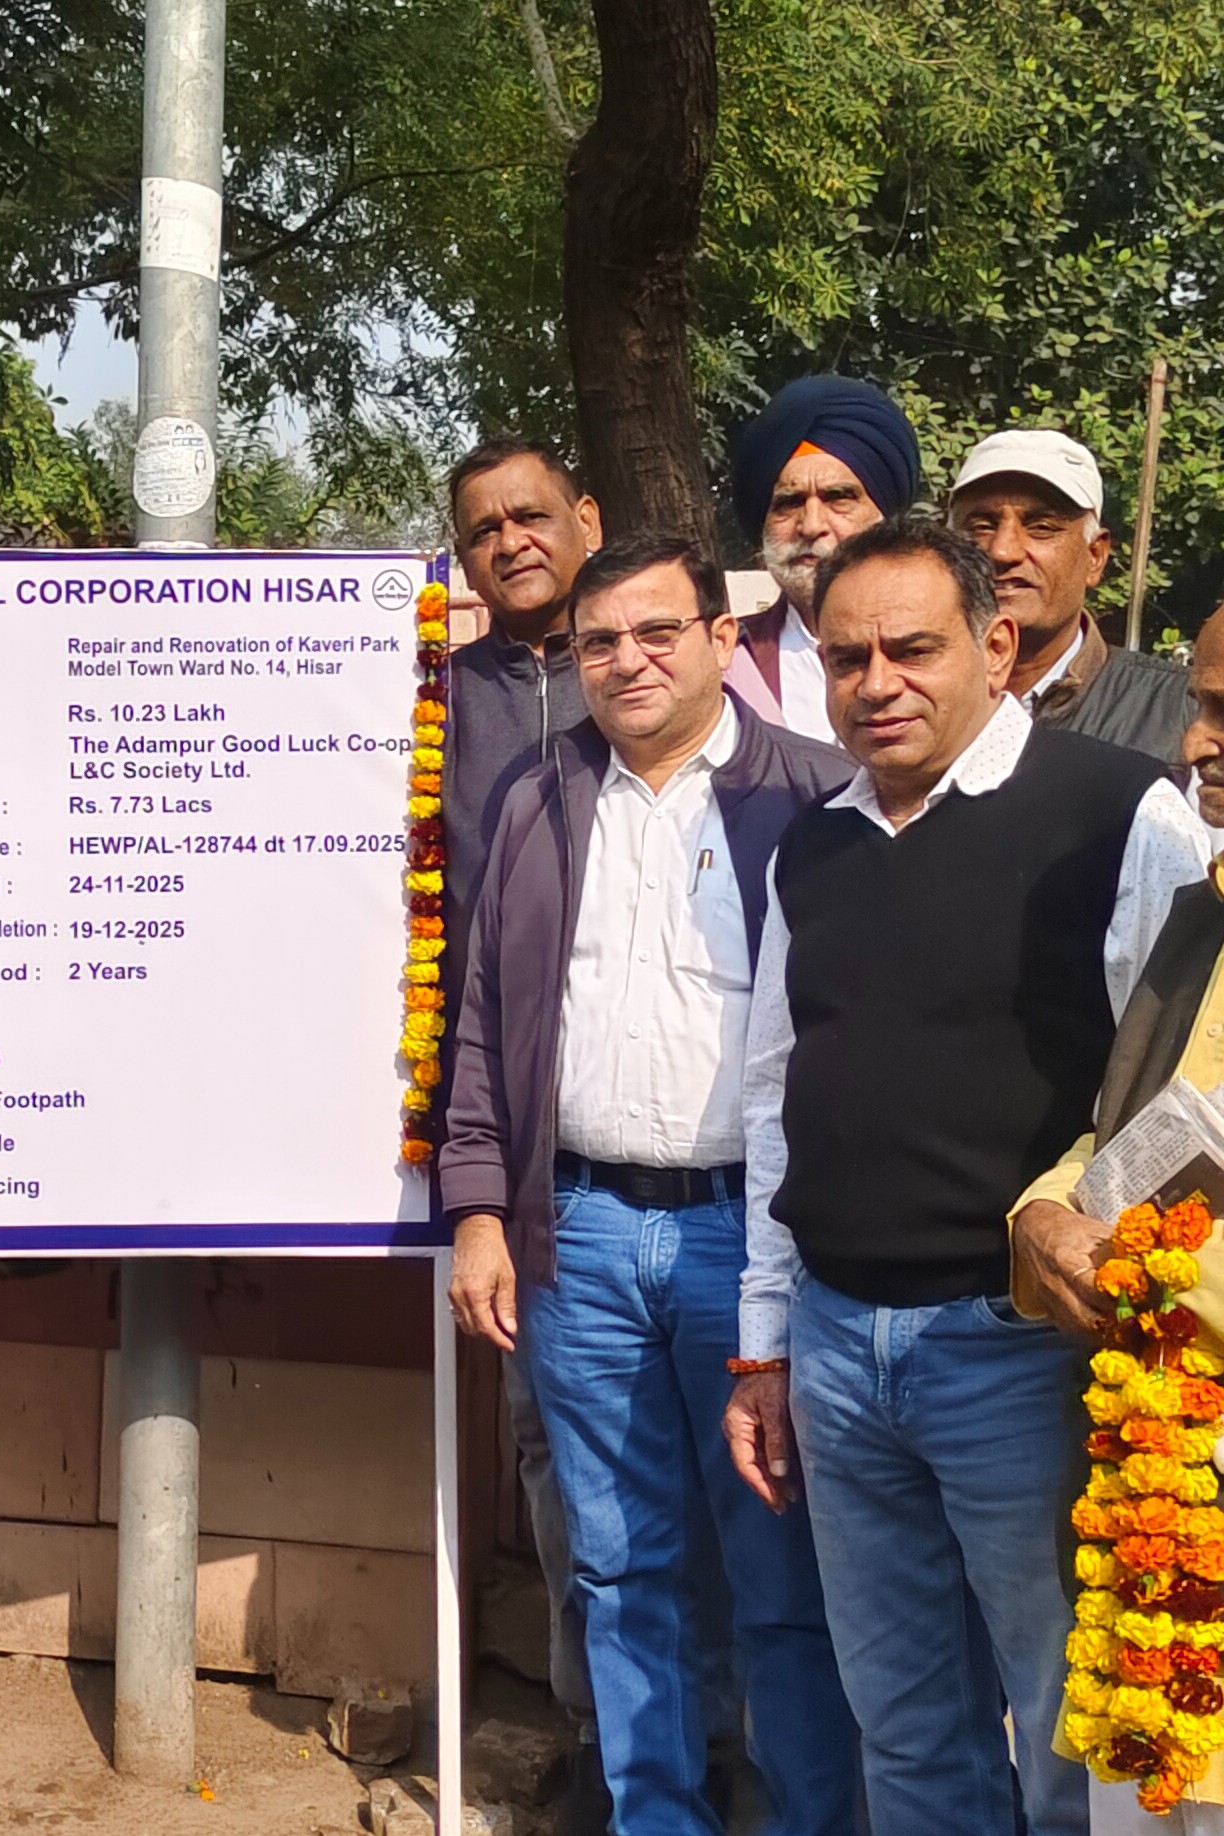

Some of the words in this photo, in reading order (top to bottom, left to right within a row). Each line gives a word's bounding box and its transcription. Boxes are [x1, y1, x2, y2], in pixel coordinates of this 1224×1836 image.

[16, 578, 251, 604] CORPORATION
[264, 578, 360, 602] HISAR
[68, 638, 126, 655] Repair
[131, 638, 163, 653] and
[170, 637, 269, 653] Renovation
[276, 636, 293, 652] of
[299, 636, 354, 652] Kaveri
[361, 636, 399, 651] Park
[69, 660, 121, 676] Model
[127, 660, 173, 676] Town
[179, 660, 224, 675] Ward
[231, 660, 259, 675] No.
[266, 659, 290, 677] 14,
[297, 659, 342, 674] Hisar
[69, 705, 102, 722] Rs.
[111, 704, 166, 722] 10.23
[174, 704, 225, 721] Lakh
[69, 736, 109, 753] The
[115, 736, 215, 756] Adampur
[222, 735, 280, 752] Good
[289, 734, 340, 752] Luck
[347, 734, 411, 755] Co-op
[70, 762, 114, 779] L&C
[123, 761, 203, 782] Society
[211, 760, 250, 778] Ltd.
[2, 801, 8, 815] :
[70, 796, 102, 814] Rs.
[110, 796, 154, 813] 7.73
[162, 796, 212, 813] Lacs
[16, 841, 22, 856] :
[70, 836, 257, 854] HEWP/AL-128744
[264, 835, 285, 853] dt
[293, 835, 405, 852] 17.09.2025
[7, 880, 13, 895] :
[70, 875, 184, 893] 24-11-2025
[53, 923, 58, 937] :
[70, 920, 184, 938] 19-12-2025
[35, 967, 41, 981] :
[69, 963, 80, 980] 2
[87, 962, 147, 980] Years
